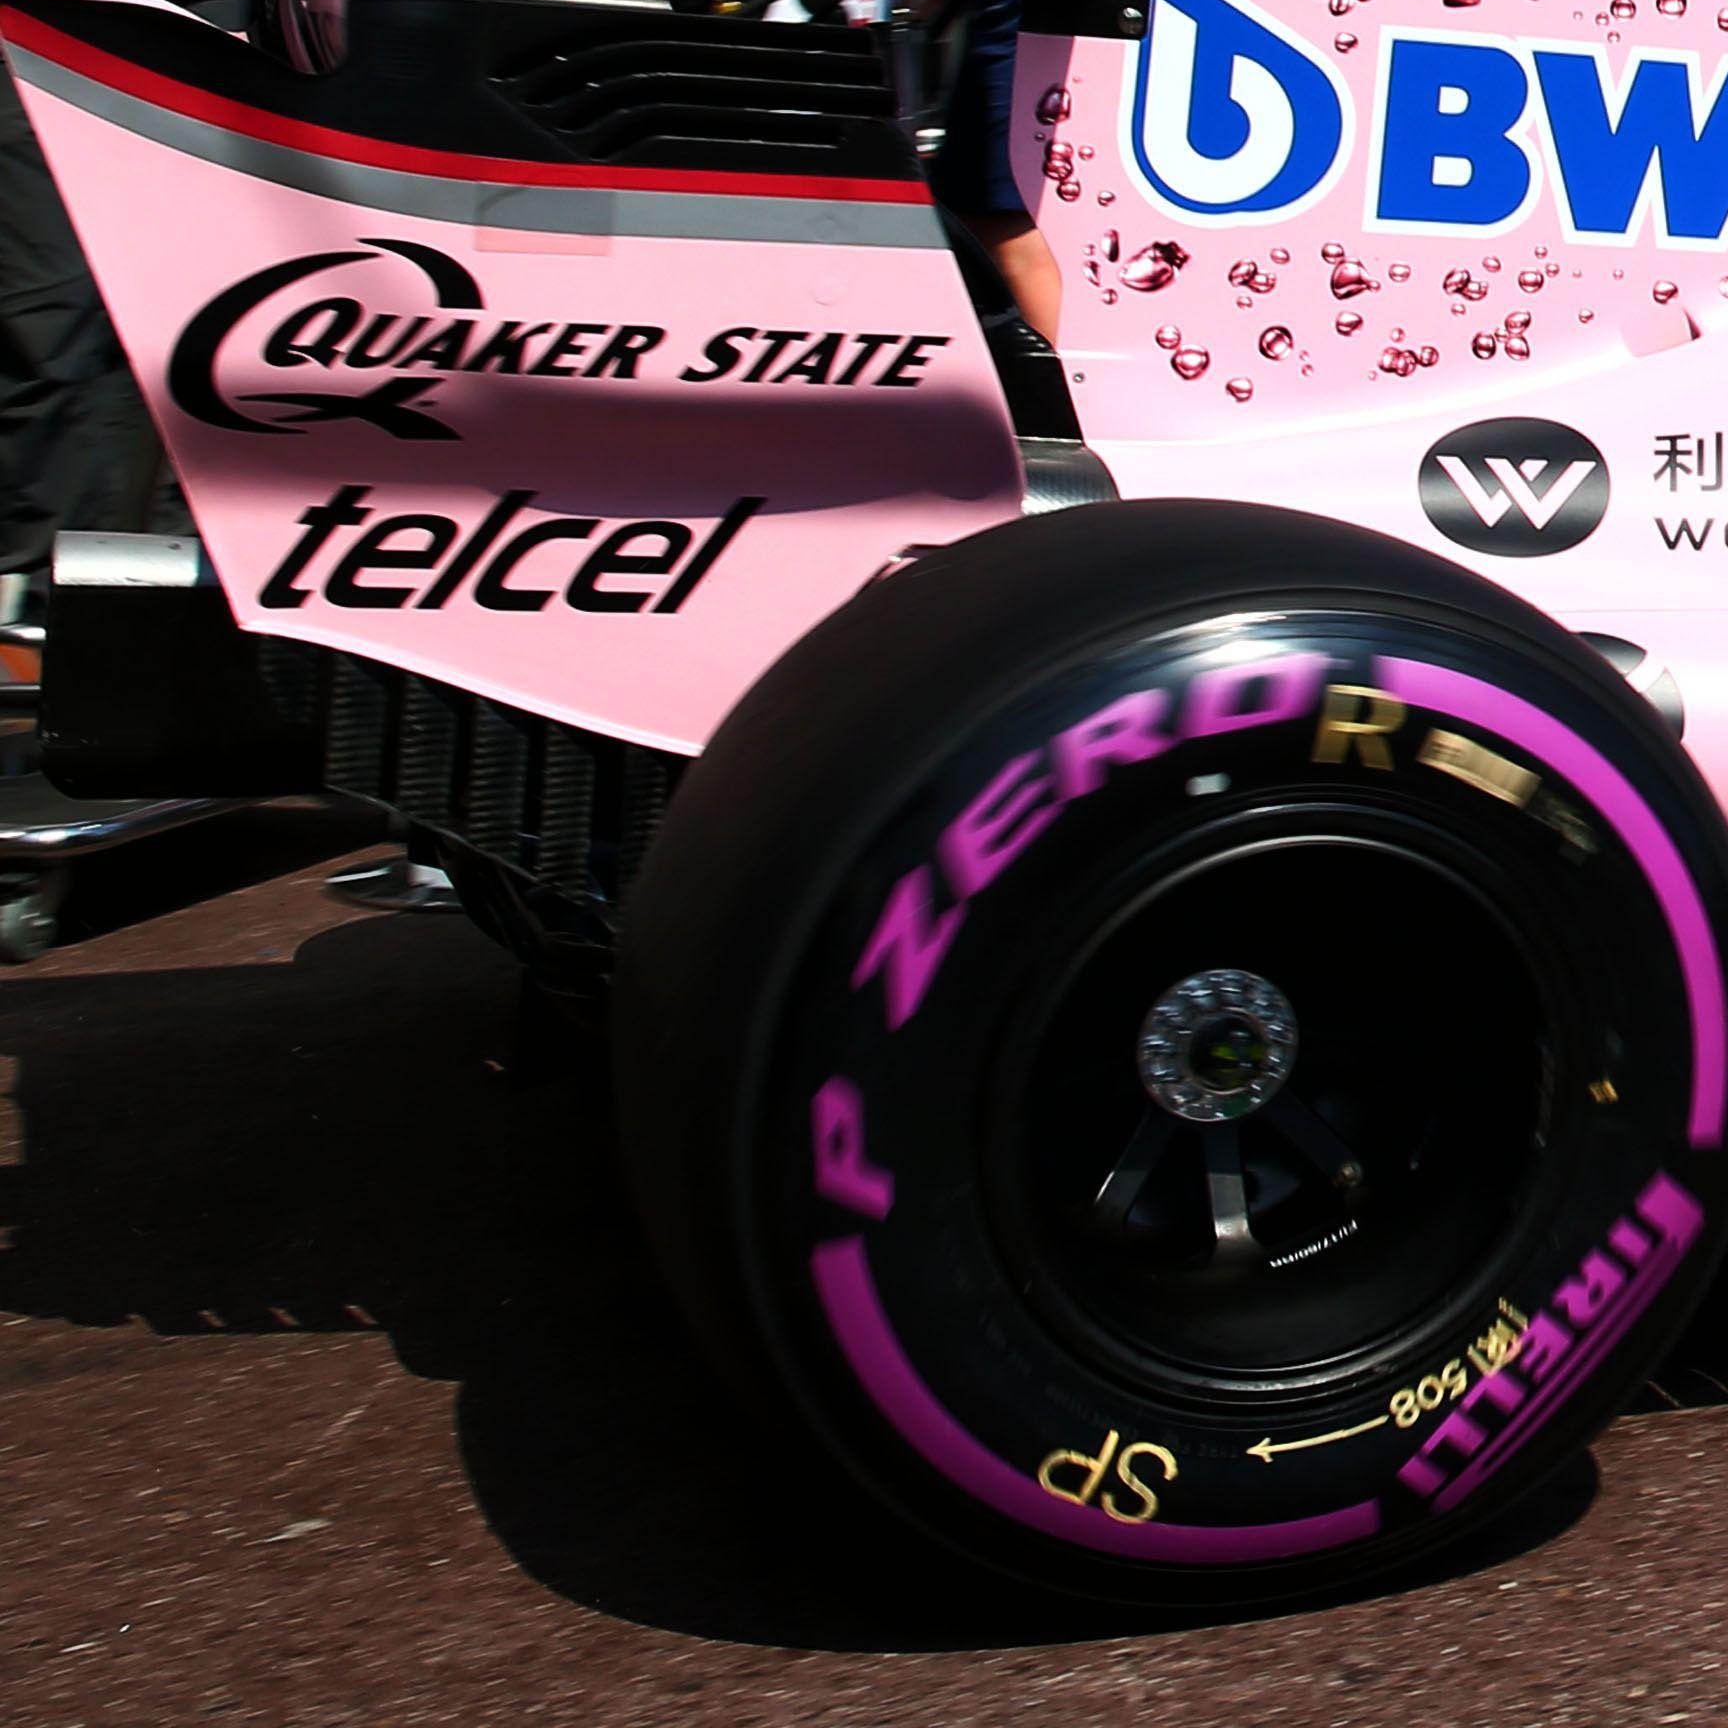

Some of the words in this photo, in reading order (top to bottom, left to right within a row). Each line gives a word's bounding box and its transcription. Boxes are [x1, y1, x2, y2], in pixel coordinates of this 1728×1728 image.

[260, 295, 667, 381] QUAKER
[678, 325, 951, 388] STATE
[257, 484, 766, 615] telcel
[852, 649, 1338, 1034] ZERO
[810, 1074, 895, 1222] P
[1388, 1357, 1469, 1429] 508
[1395, 1168, 1706, 1512] PIRELLI
[1037, 1425, 1179, 1525] SP
